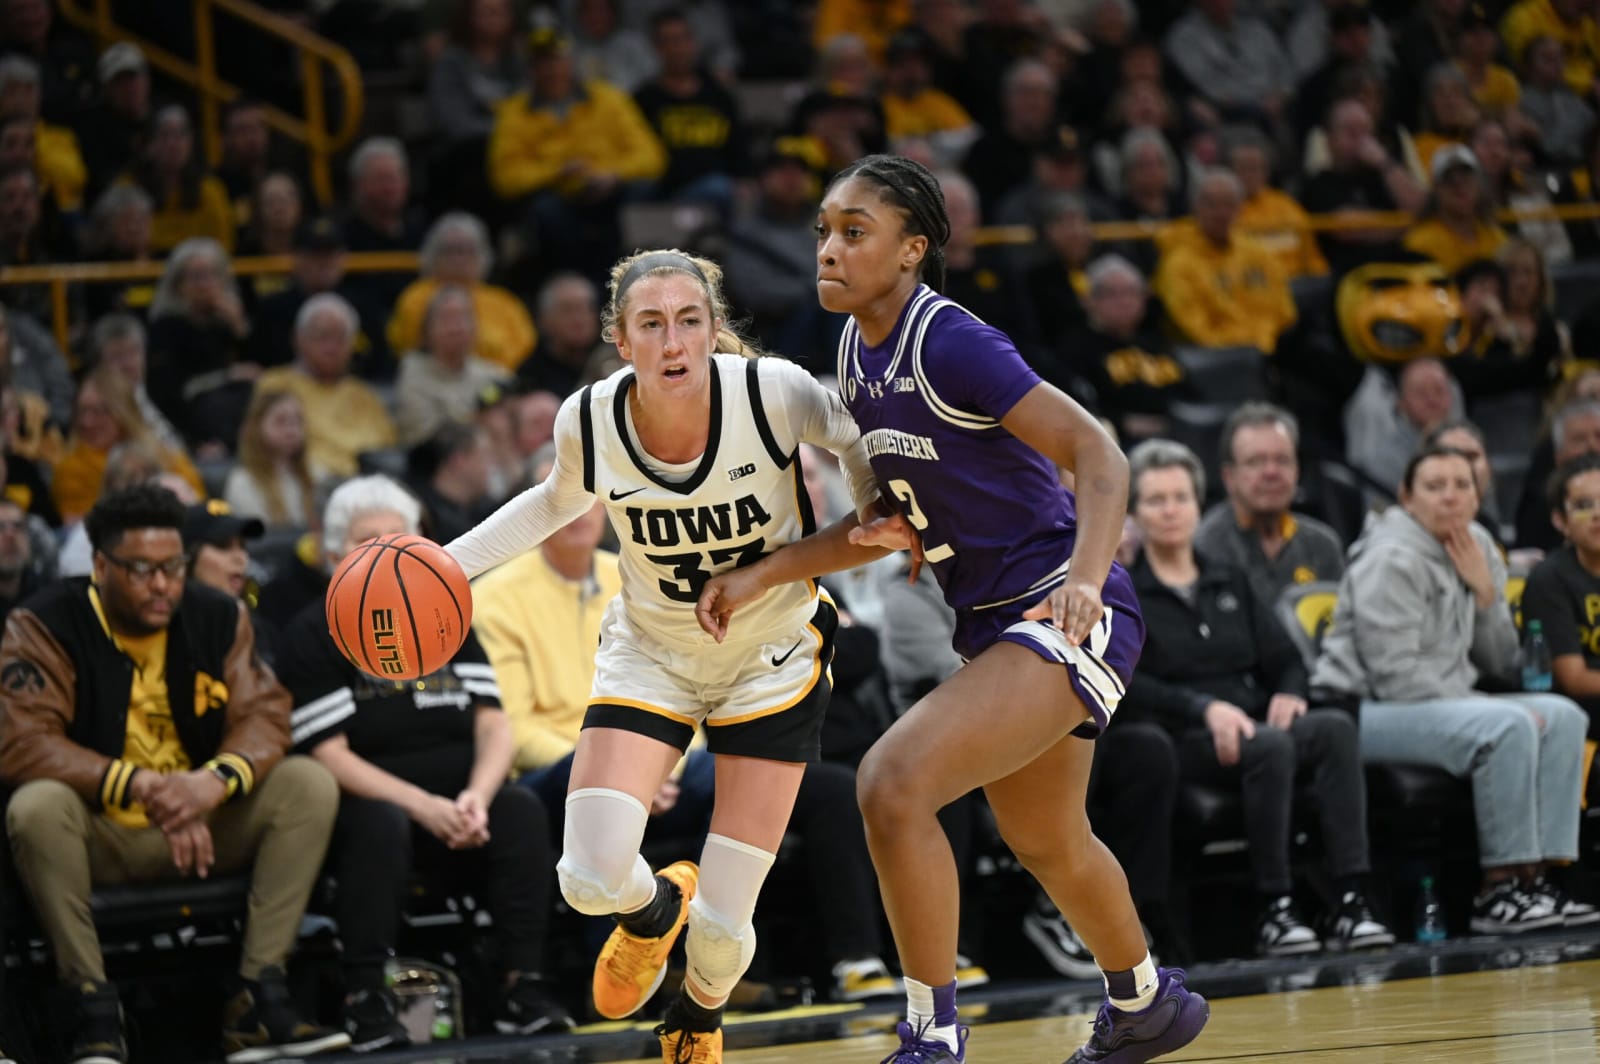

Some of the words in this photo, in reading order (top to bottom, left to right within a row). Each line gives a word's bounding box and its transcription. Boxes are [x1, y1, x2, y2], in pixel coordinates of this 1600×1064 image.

[863, 428, 940, 460] THWESTERN
[626, 494, 771, 547] IOWA
[372, 608, 404, 674] ELITE
